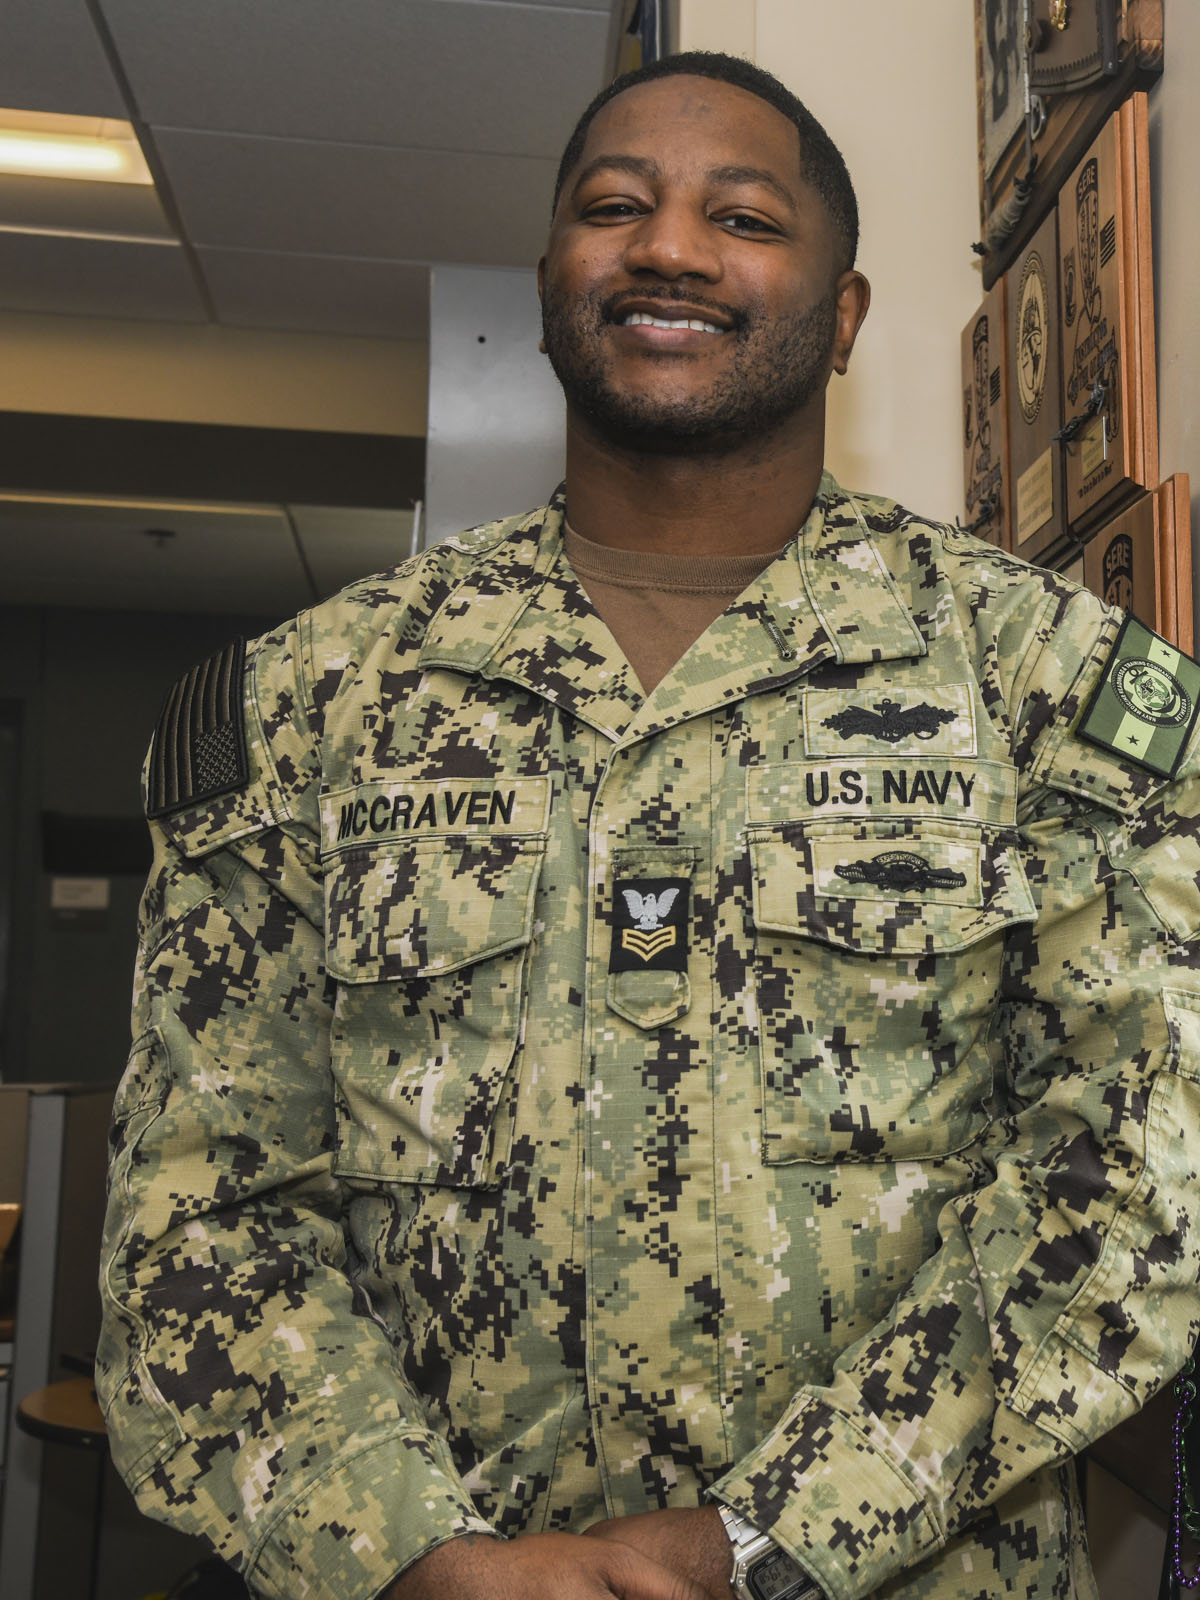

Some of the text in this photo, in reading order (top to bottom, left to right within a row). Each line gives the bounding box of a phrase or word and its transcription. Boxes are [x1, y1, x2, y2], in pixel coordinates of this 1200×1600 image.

[1106, 541, 1129, 579] SERE
[806, 769, 976, 807] U.S. NAVY
[337, 790, 516, 842] MCCRAVEN
